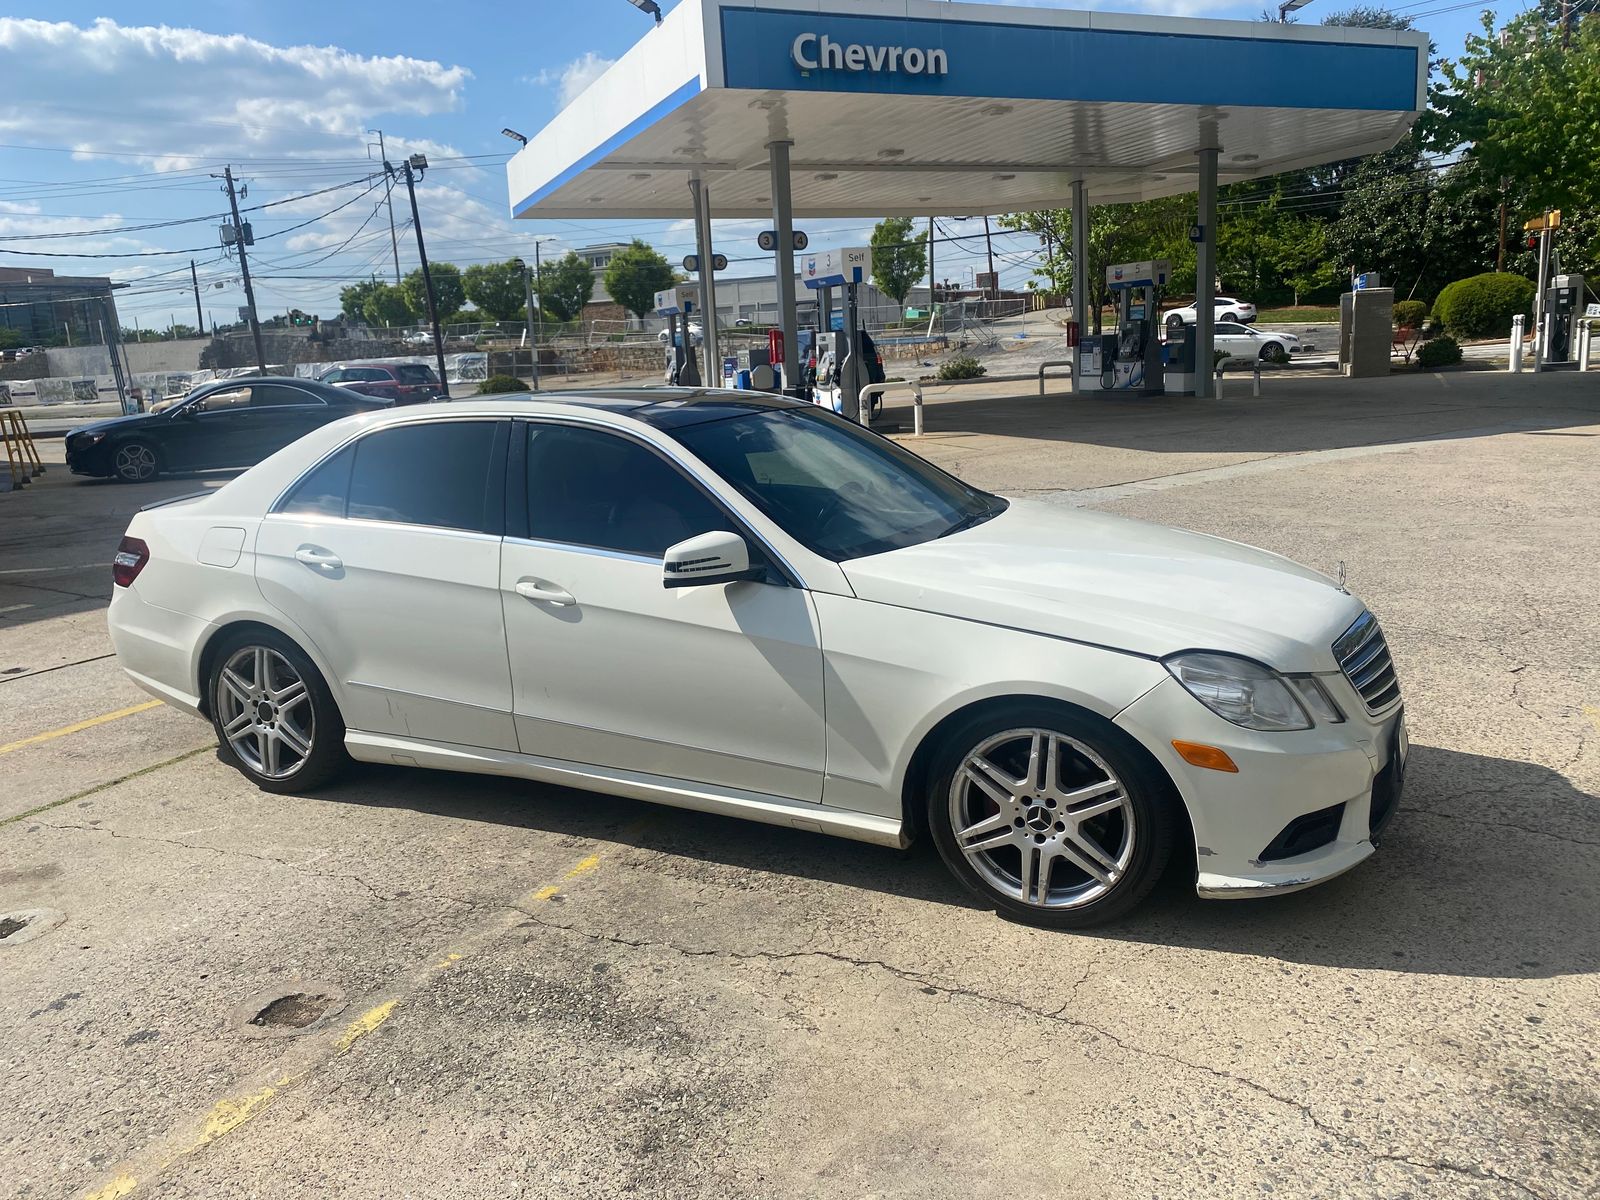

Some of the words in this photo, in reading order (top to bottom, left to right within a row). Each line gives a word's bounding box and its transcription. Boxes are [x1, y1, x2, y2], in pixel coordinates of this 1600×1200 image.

[792, 32, 948, 74] Chevron
[763, 236, 770, 245] 3
[797, 236, 804, 245] 4
[826, 254, 831, 267] 3
[848, 253, 865, 262] Self
[717, 258, 723, 267] 2
[1135, 264, 1141, 273] 5
